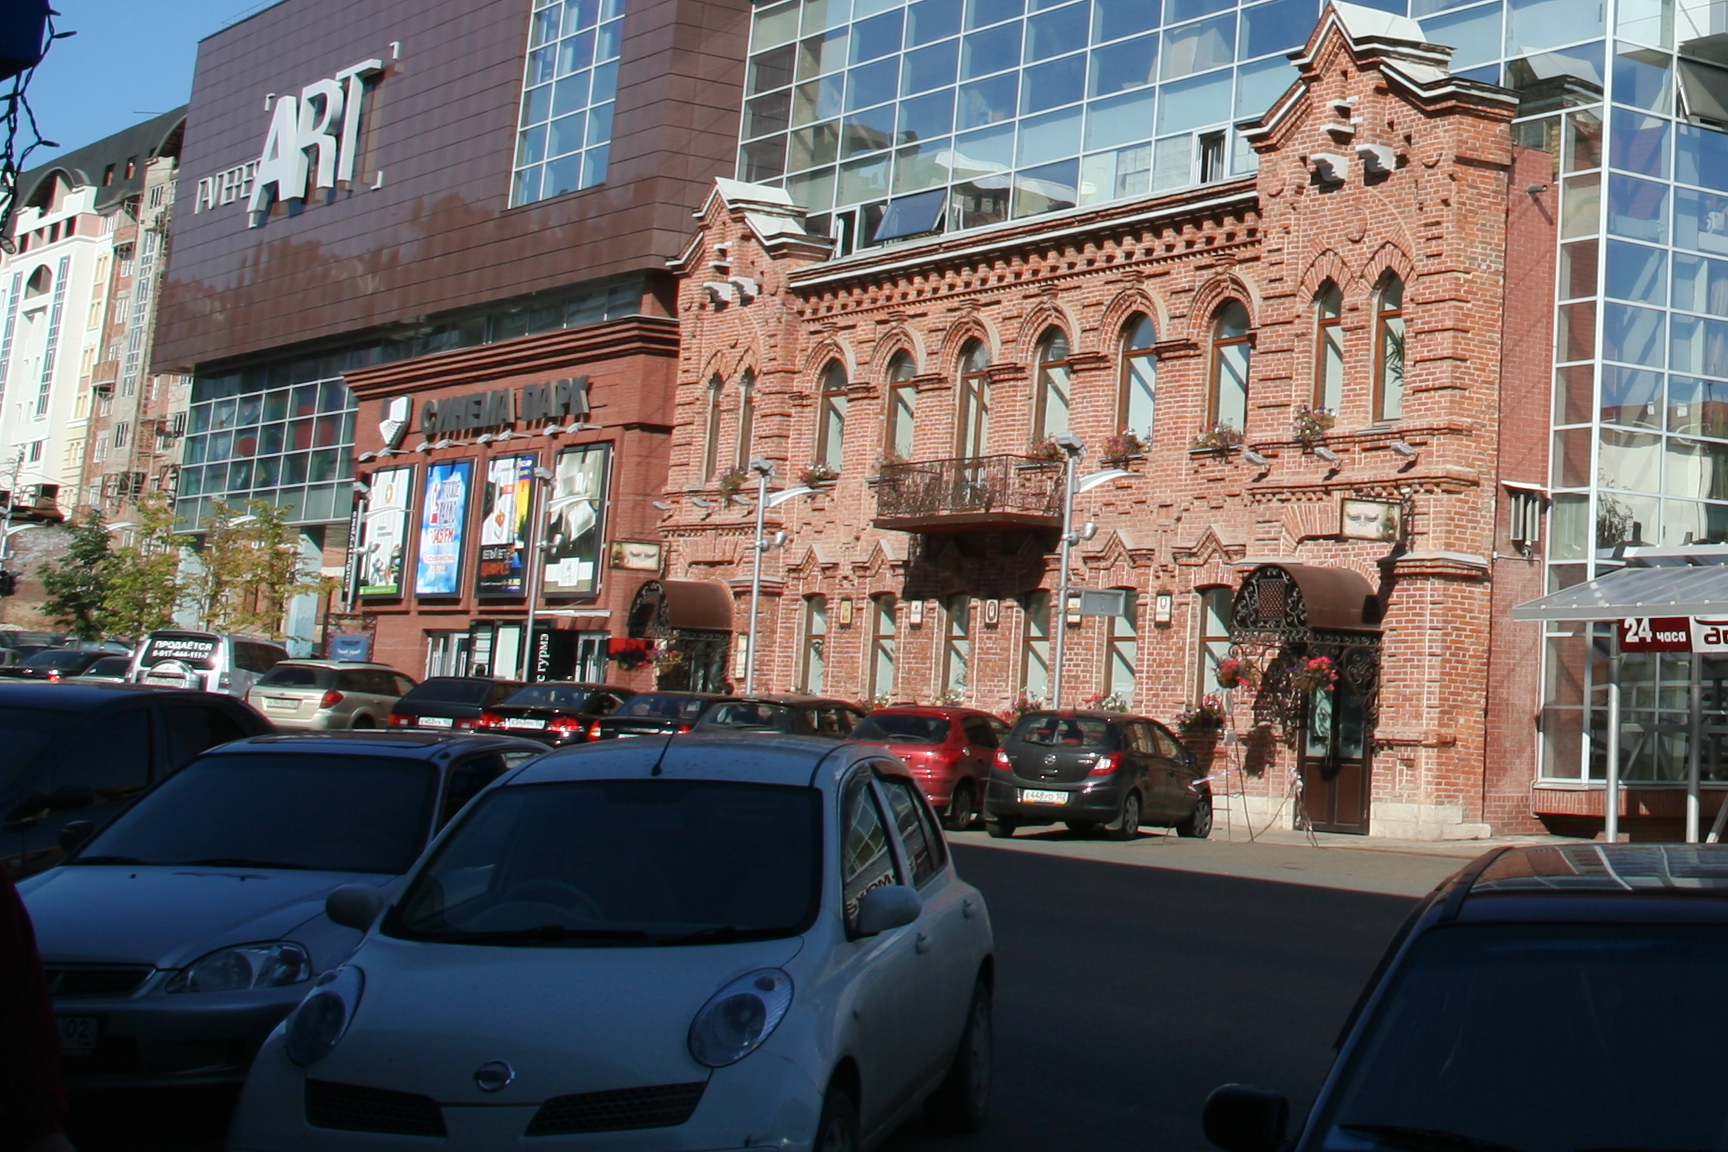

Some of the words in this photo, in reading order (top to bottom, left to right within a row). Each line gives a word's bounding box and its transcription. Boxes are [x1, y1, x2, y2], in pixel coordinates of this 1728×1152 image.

[247, 58, 382, 201] ART
[421, 387, 515, 435] СИНЕМА
[522, 375, 590, 422] ПАРК
[537, 633, 550, 674] гурмэ
[1624, 617, 1653, 643] 24
[1656, 630, 1686, 643] часа
